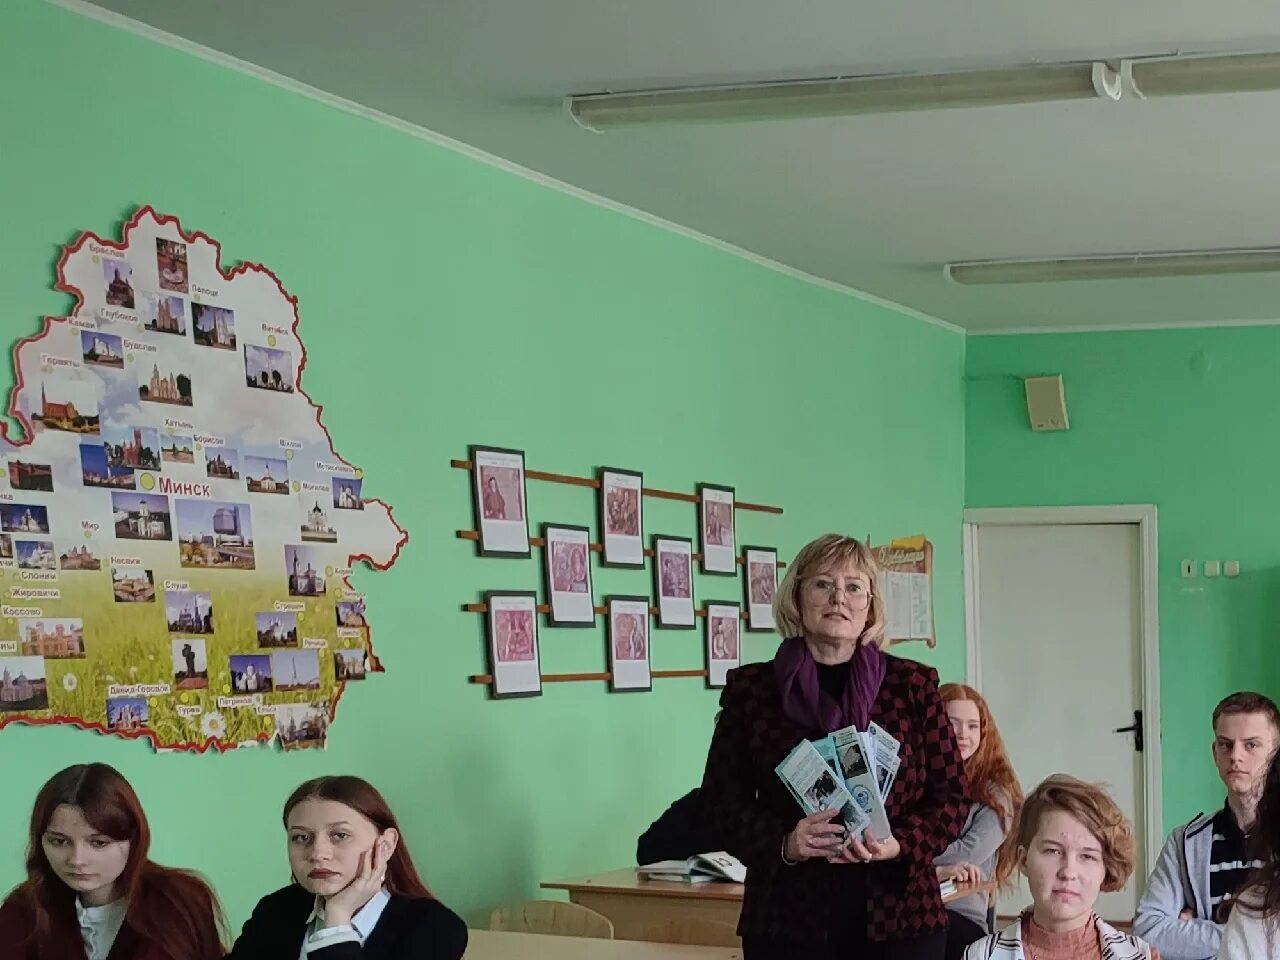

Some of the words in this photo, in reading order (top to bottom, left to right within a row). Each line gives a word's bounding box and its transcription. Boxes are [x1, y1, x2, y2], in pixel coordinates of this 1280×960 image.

[158, 477, 210, 496] Минск
[81, 521, 100, 531] Мир
[21, 571, 56, 580] Слоним
[12, 588, 59, 598] Жировичи
[3, 607, 41, 615] Коссово
